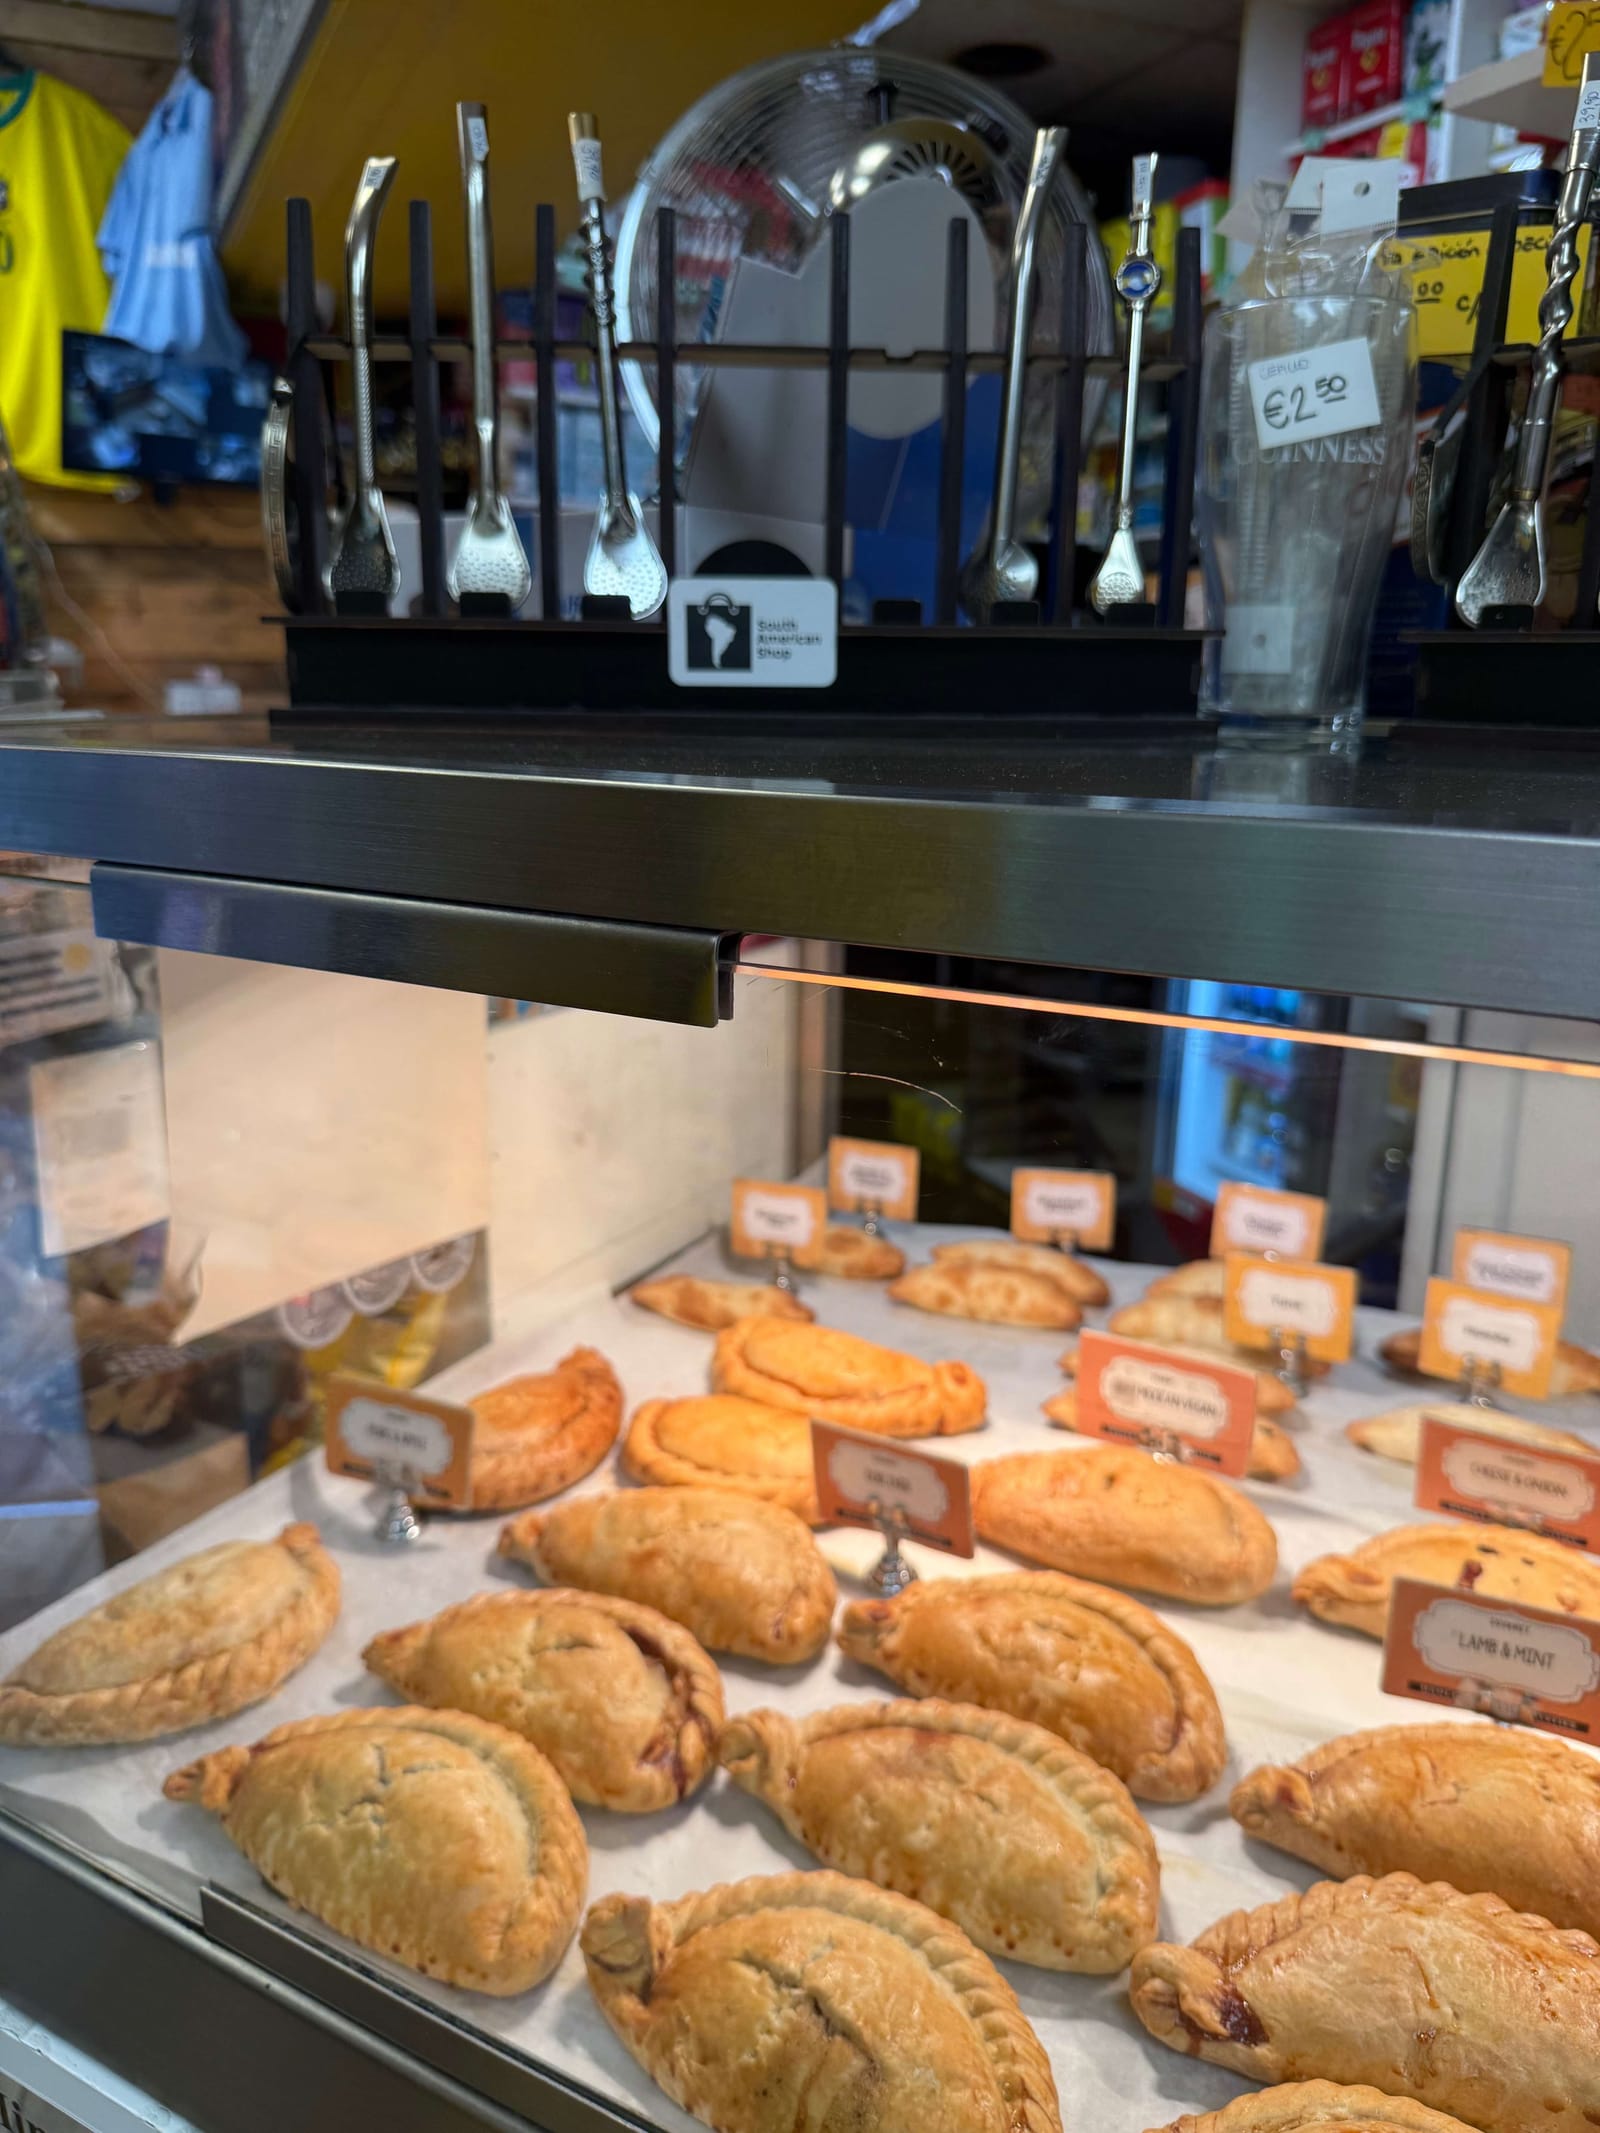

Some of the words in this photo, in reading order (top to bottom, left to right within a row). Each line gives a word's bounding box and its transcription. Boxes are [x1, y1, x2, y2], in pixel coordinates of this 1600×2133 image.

[1458, 1633, 1498, 1653] LAMB
[1500, 1641, 1510, 1658] &
[1513, 1646, 1556, 1671] MINT
